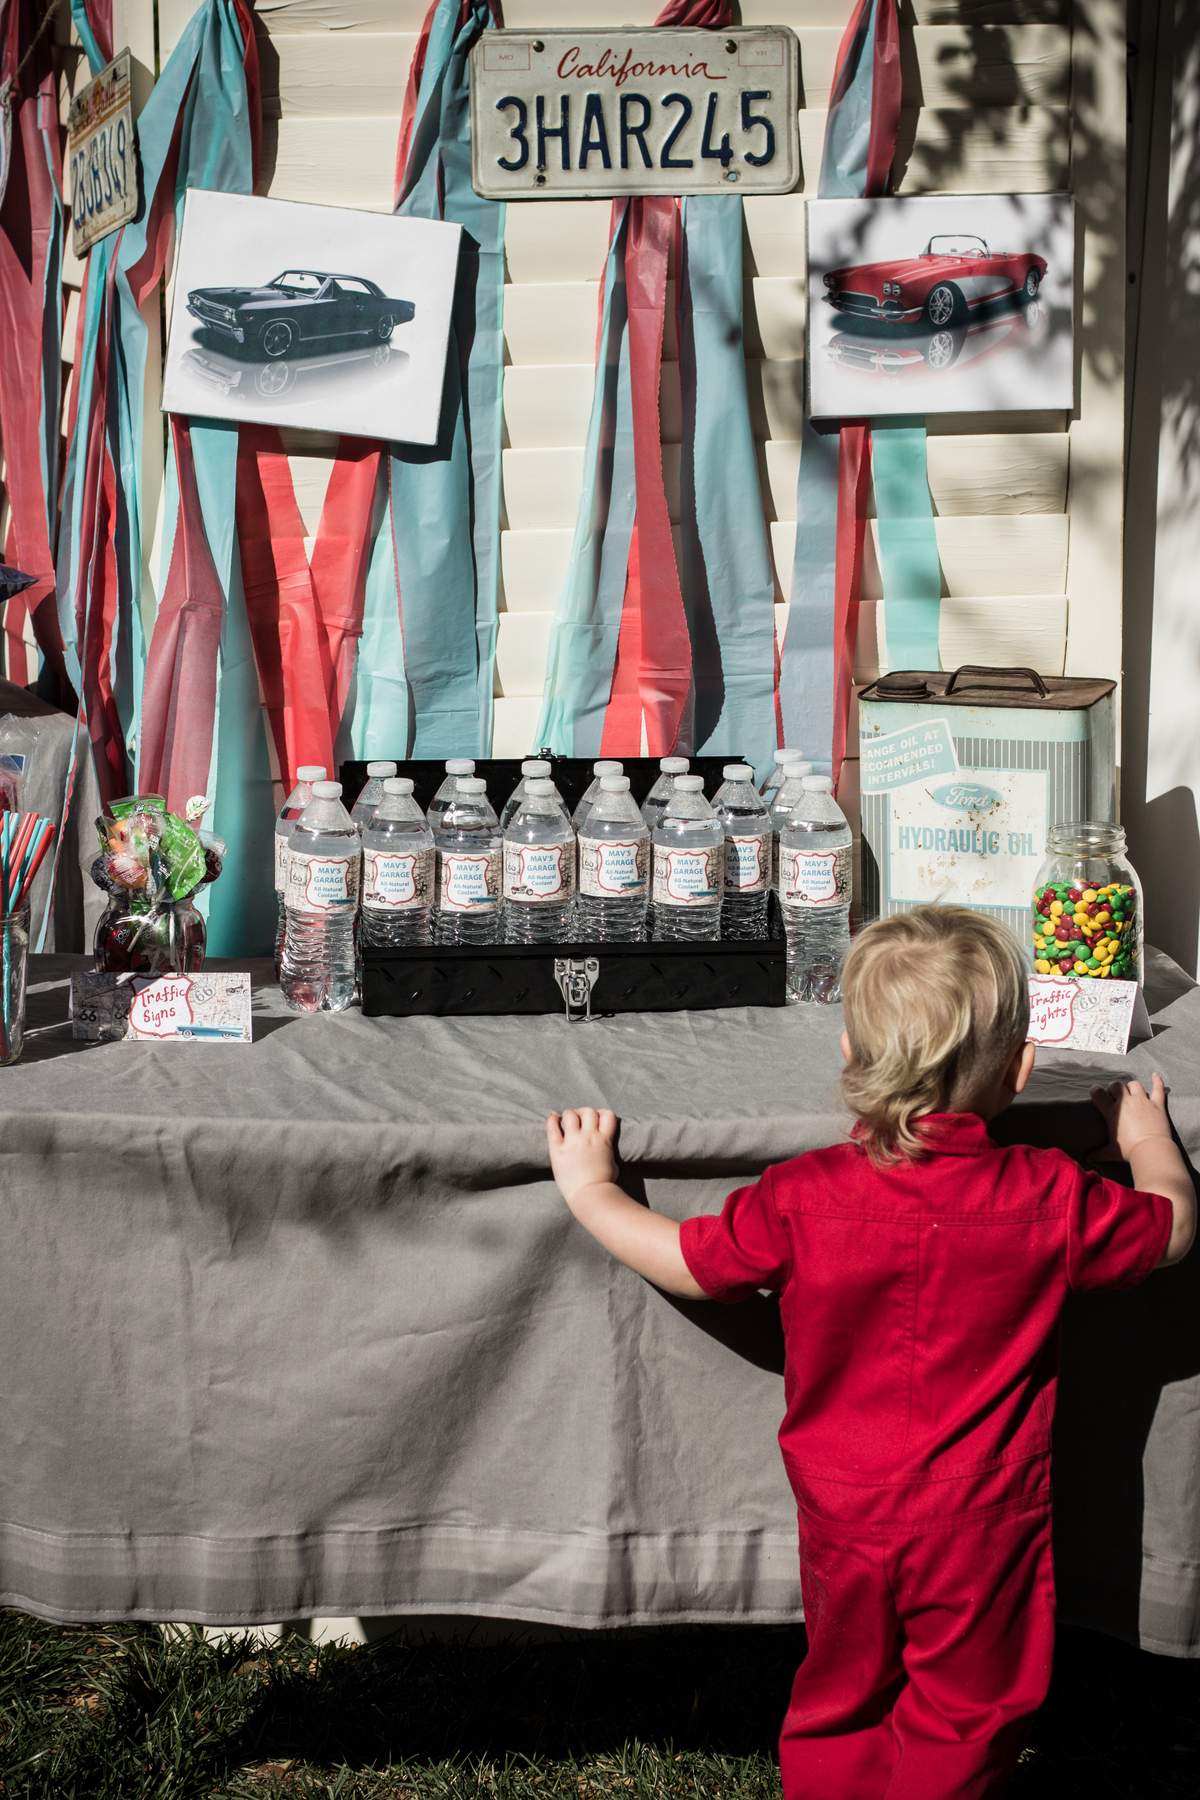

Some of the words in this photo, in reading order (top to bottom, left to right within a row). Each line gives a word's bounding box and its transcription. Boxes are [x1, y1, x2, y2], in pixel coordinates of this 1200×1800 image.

[557, 46, 727, 86] California
[495, 90, 775, 172] 3HAR245
[900, 736, 918, 749] OIL
[924, 729, 940, 741] AT
[863, 743, 944, 772] ECOMMENDED
[944, 786, 991, 806] Ford
[898, 825, 1000, 855] HYDRAULIC
[1008, 831, 1038, 857] OIL
[608, 849, 632, 857] MAV'S
[530, 854, 554, 862] MAV'S
[605, 858, 635, 866] GARAGE
[727, 855, 756, 863] GARAGE
[527, 863, 557, 872] GARAGE
[804, 860, 828, 868] MAV'S
[318, 866, 342, 874] MAV'S
[673, 867, 704, 875] GARAGE
[801, 869, 832, 877] GARAGE
[313, 876, 344, 884] GARAGE
[453, 873, 483, 881] GARAGE
[138, 985, 188, 1008] Traffic
[1028, 989, 1071, 1009] Traffic
[80, 1008, 97, 1022] 66
[143, 1006, 176, 1028] Signs
